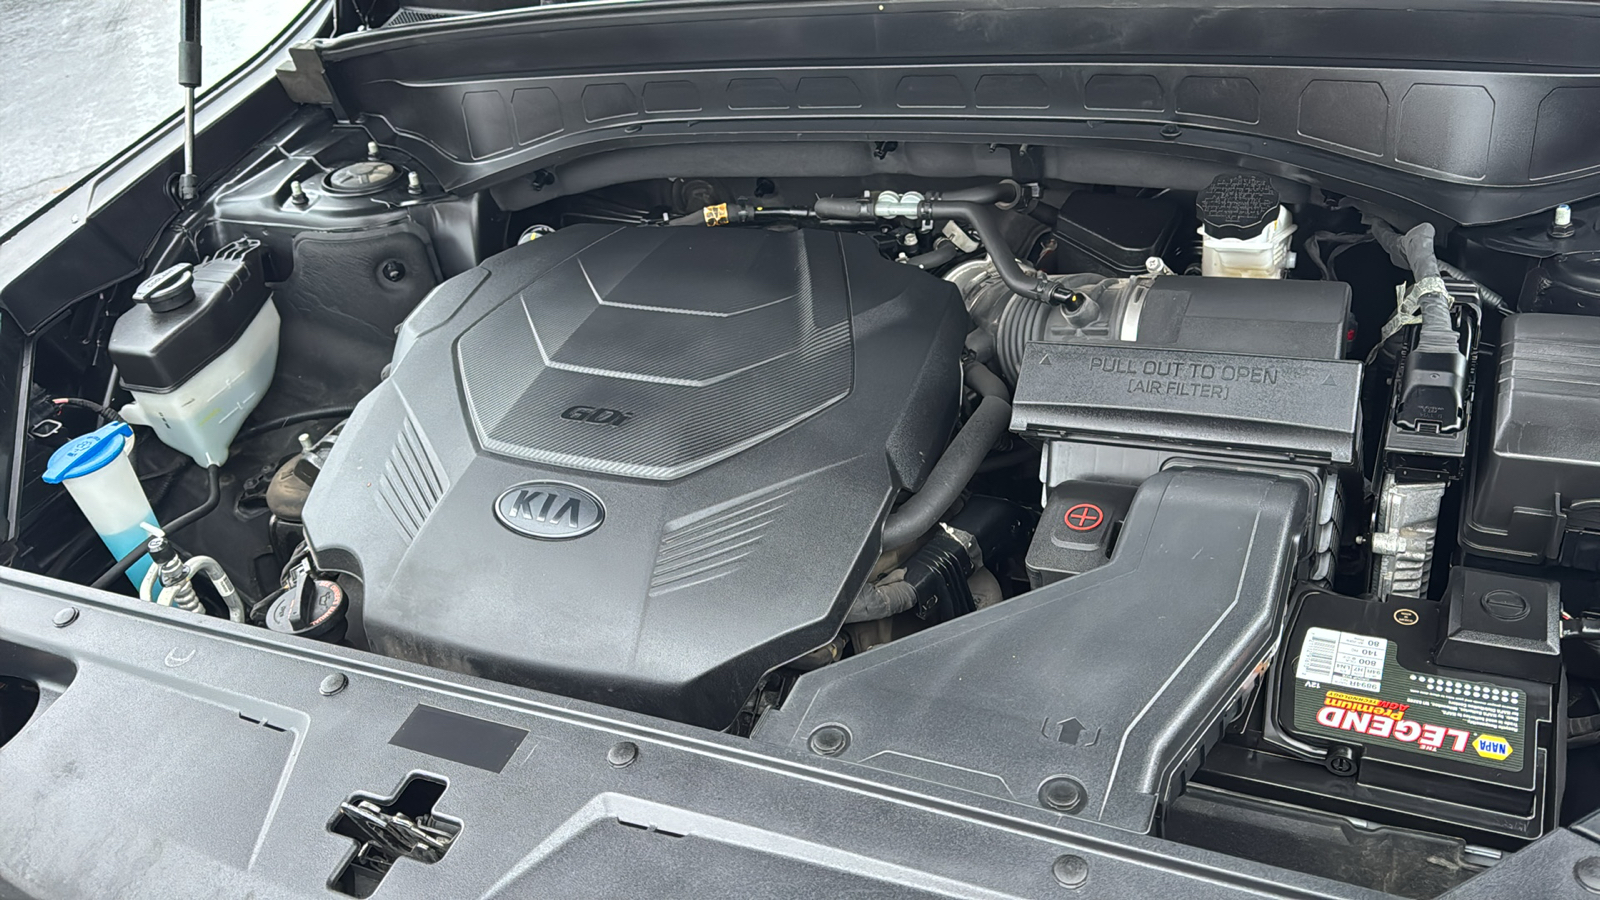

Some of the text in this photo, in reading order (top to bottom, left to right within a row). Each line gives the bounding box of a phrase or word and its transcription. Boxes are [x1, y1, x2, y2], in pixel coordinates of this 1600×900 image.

[1088, 356, 1279, 385] PULL OUT TO OPEN
[508, 489, 582, 529] KIA
[1367, 639, 1380, 647] 80
[1361, 648, 1378, 657] 140
[1358, 658, 1377, 666] 800
[1304, 680, 1321, 689] 12V
[1349, 680, 1378, 690] 9894R
[1327, 691, 1410, 711] AGM TECHNOLOGY
[1323, 697, 1405, 721] Premium
[1316, 706, 1470, 753] LEGEND
[1418, 744, 1438, 752] THE
[1478, 739, 1507, 755] NAPA
